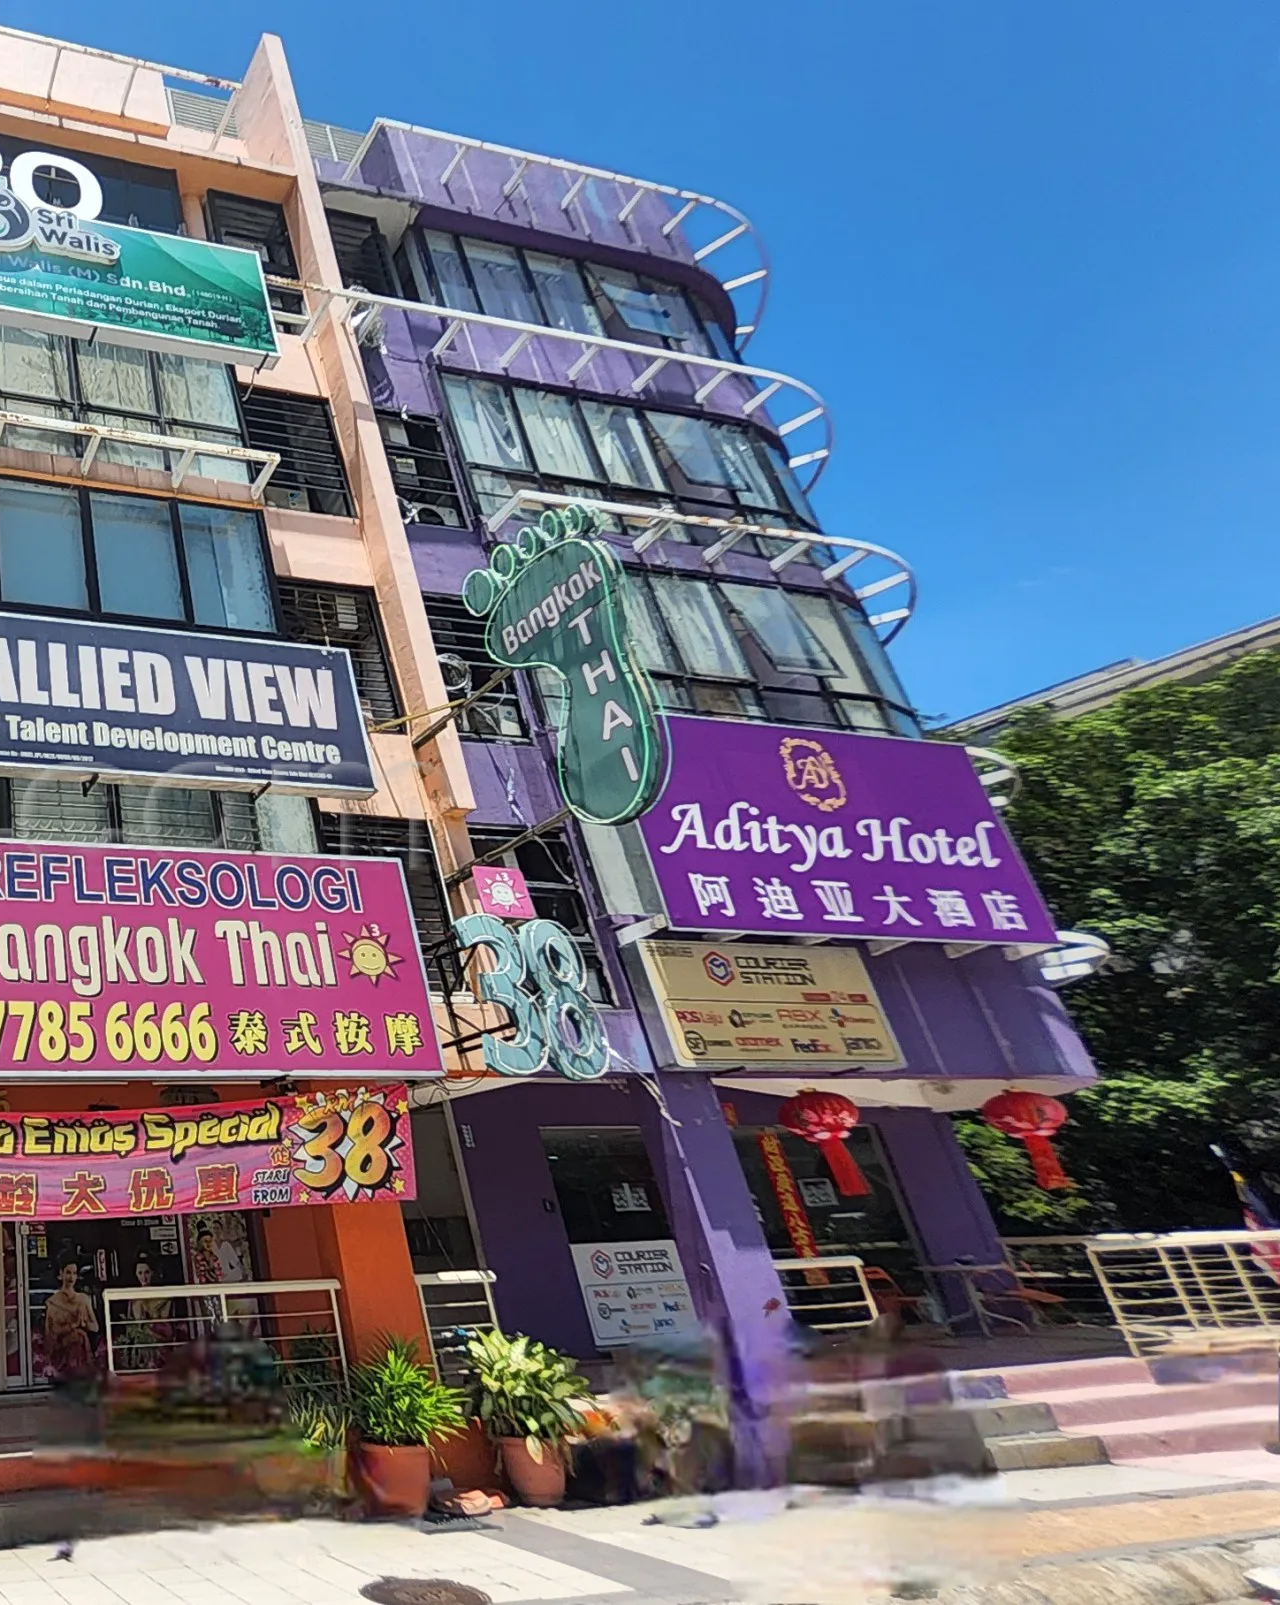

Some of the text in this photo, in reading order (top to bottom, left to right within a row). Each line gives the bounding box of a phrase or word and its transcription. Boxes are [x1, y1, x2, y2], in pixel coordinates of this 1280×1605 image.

[37, 208, 74, 230] Sri
[39, 226, 117, 257] Walis
[19, 277, 53, 291] dalam
[124, 296, 164, 312] Durian,
[165, 304, 206, 318] Eksport
[68, 266, 101, 283] (M)
[50, 292, 84, 306] Tanah
[86, 299, 108, 311] dan
[108, 304, 185, 323] Pembangunan
[502, 560, 602, 656] Bangkok
[183, 656, 338, 732] VIEW
[568, 607, 639, 782] THAI
[4, 714, 90, 747] Talent
[93, 725, 258, 761] Development
[261, 733, 342, 766] Centre
[660, 800, 1002, 873] Aditya Hotel
[687, 871, 1029, 932] 阿迪亚大酒店
[215, 917, 338, 988] Thai
[733, 955, 810, 971] COURIER
[452, 912, 610, 1082] 38
[740, 971, 817, 986] STATION
[106, 1000, 219, 1065] 6666
[227, 1009, 425, 1058] 泰式按摩
[22, 1116, 136, 1158] Emas
[142, 1101, 282, 1160] Special
[293, 1101, 392, 1188] 38
[253, 1169, 290, 1185] START
[253, 1187, 291, 1204] FROM
[614, 1249, 670, 1262] COURIER
[618, 1262, 676, 1275] STATION
